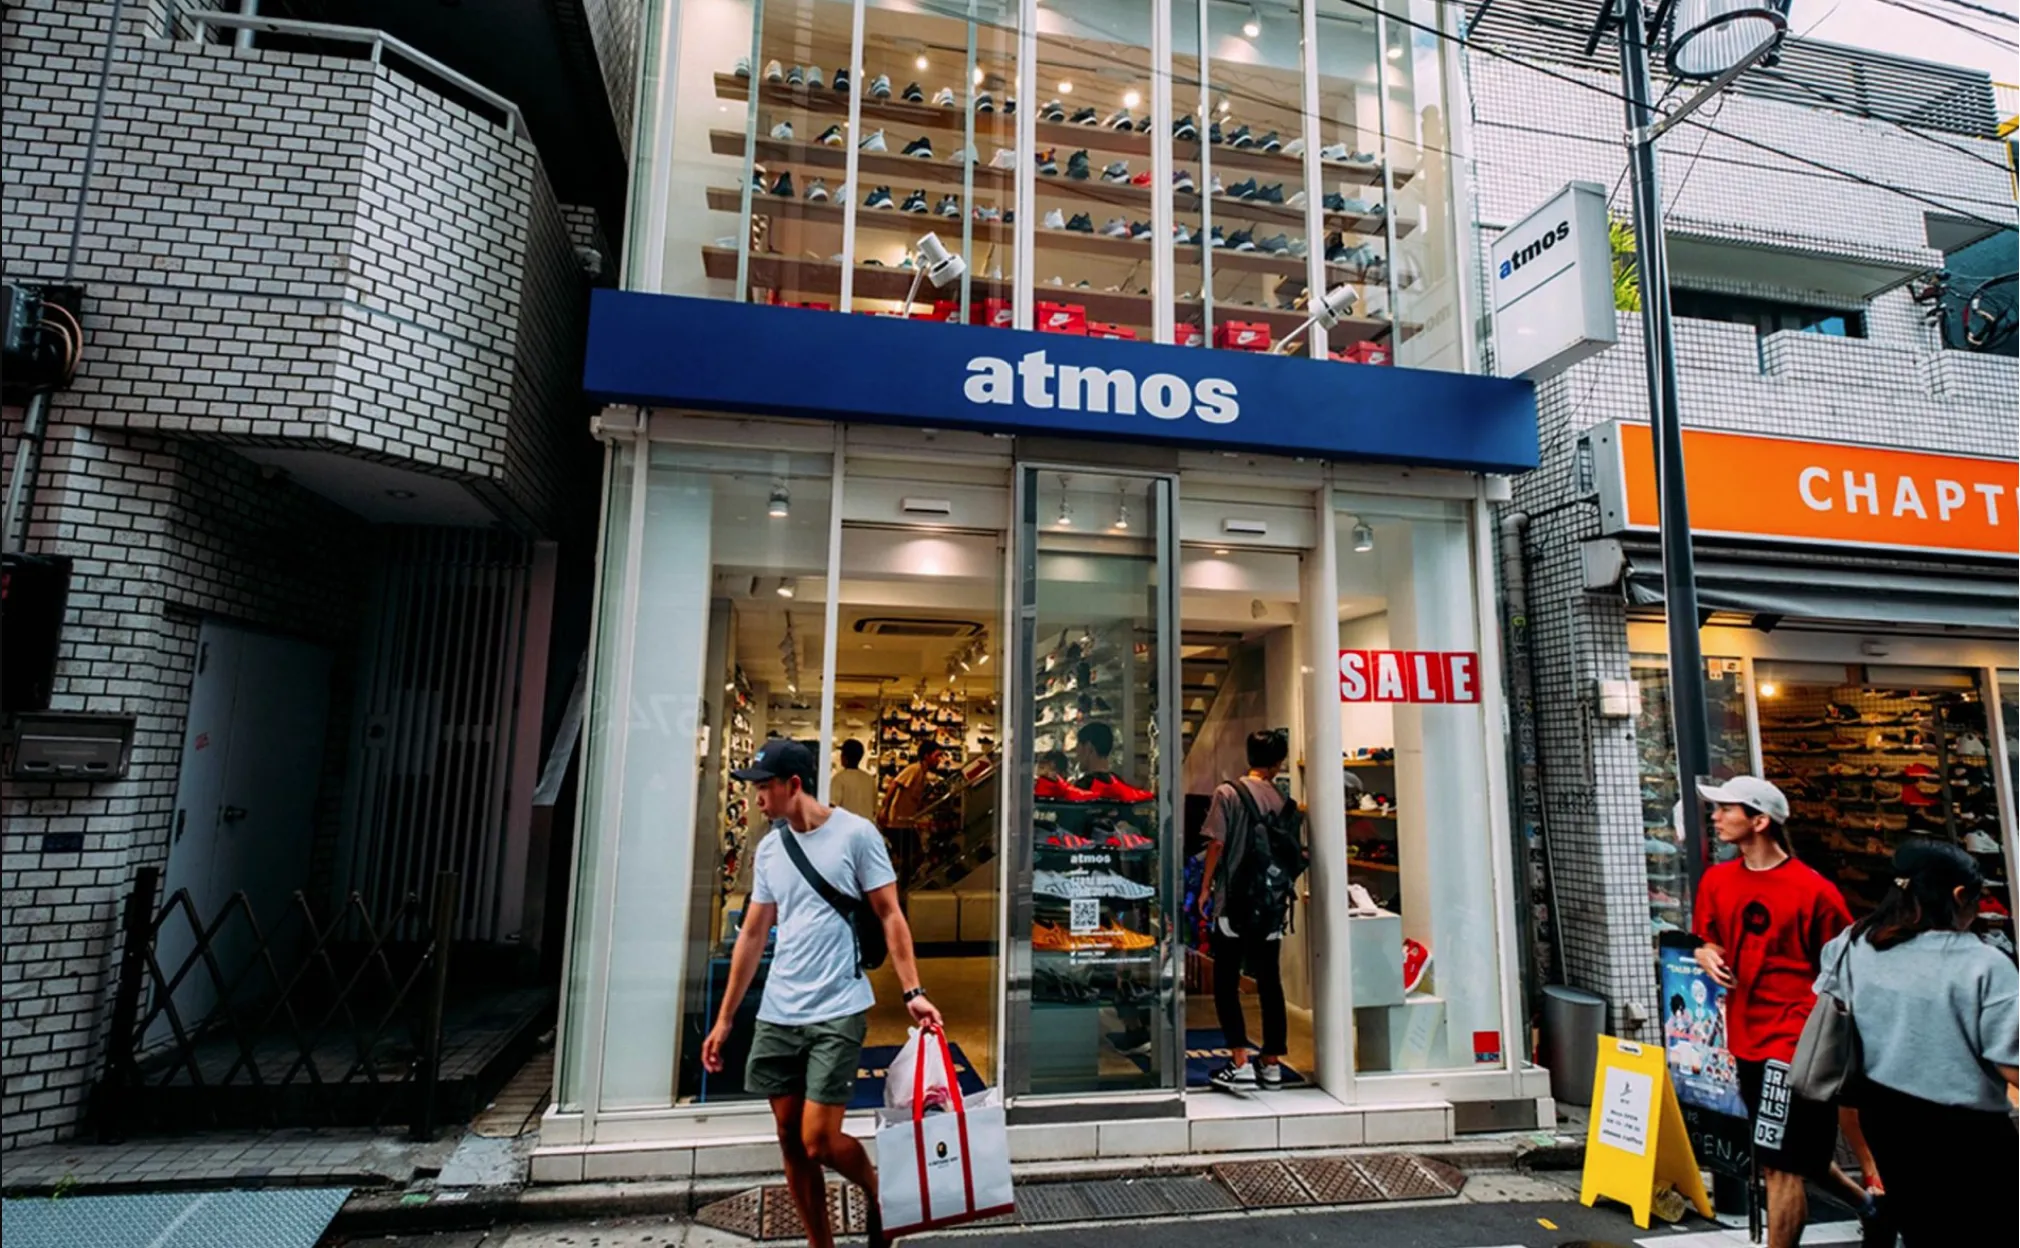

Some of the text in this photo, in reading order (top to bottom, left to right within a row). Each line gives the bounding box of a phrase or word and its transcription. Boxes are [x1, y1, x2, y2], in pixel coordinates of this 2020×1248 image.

[1499, 221, 1570, 280] atmos
[964, 349, 1240, 425] atmos
[1798, 466, 2019, 526] CHAPT
[1340, 653, 1473, 700] SALE
[1070, 853, 1112, 864] atmos
[1759, 1101, 1785, 1119] ALS
